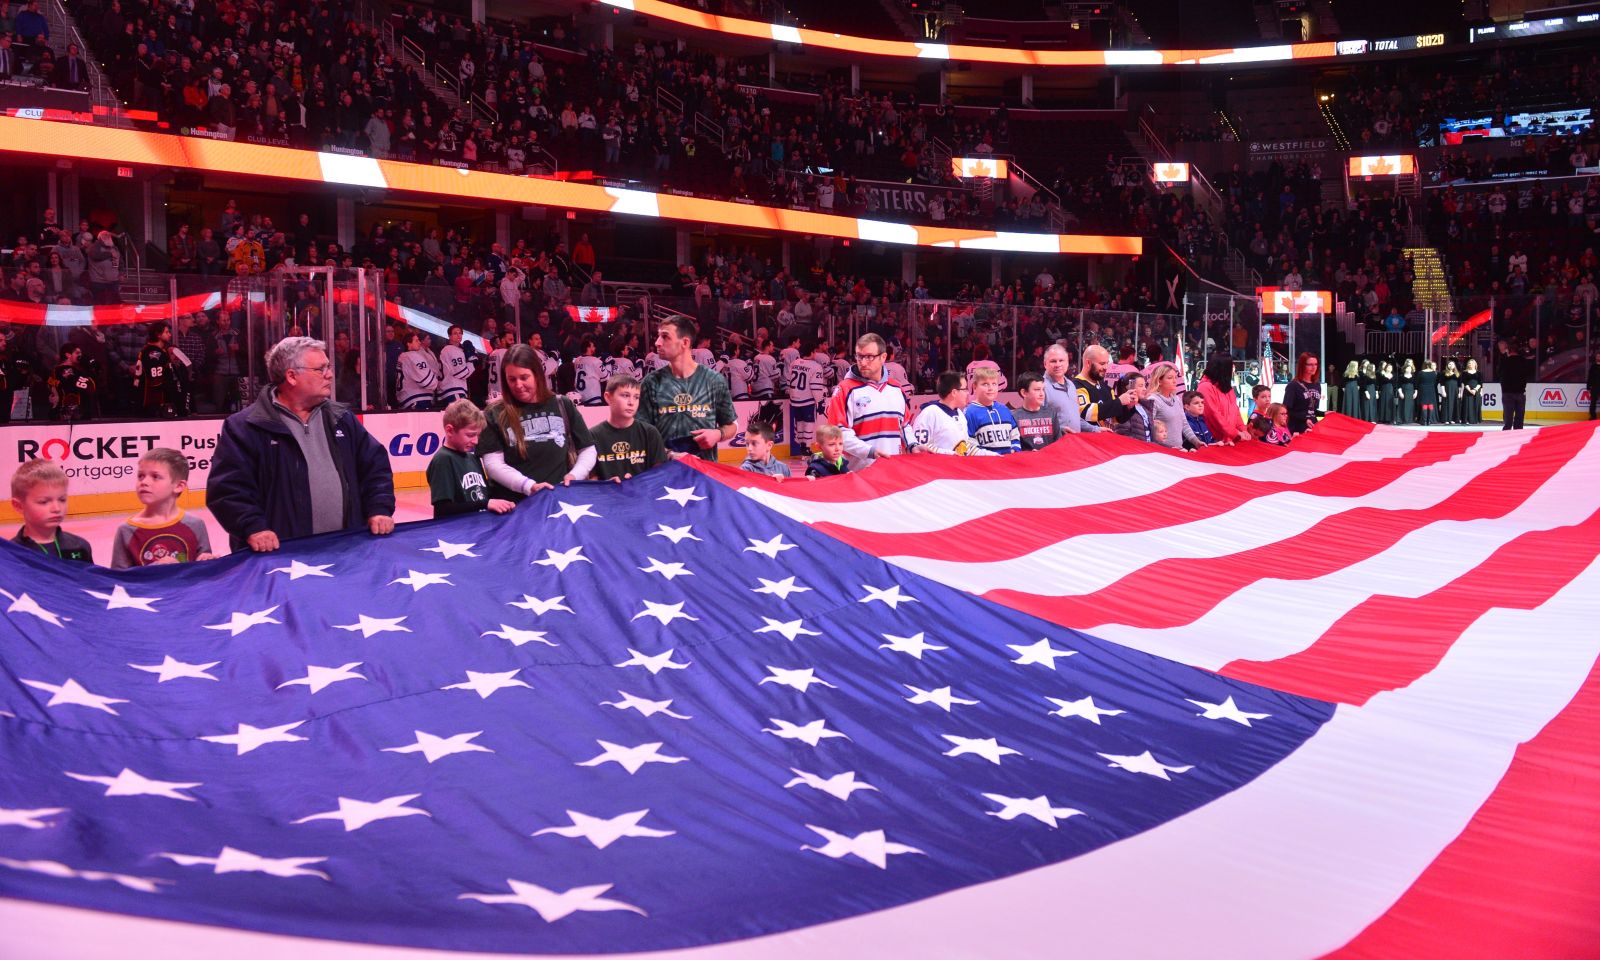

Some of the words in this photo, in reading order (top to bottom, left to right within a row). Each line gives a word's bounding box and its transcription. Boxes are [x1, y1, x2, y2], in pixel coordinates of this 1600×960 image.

[1375, 40, 1398, 51] TOTAL
[1416, 34, 1444, 48] $1020
[190, 127, 228, 140] Huntington
[247, 135, 267, 144] CLUB
[268, 137, 290, 146] LEVEL
[330, 144, 364, 156] Huntington
[1262, 141, 1326, 151] WESTFIELD
[439, 158, 469, 169] Huntington
[416, 361, 427, 370] 30
[451, 357, 463, 367] 39
[151, 366, 163, 378] 82
[790, 371, 806, 391] 20
[658, 404, 711, 415] MEDINA
[1032, 417, 1053, 427] STATE
[1023, 426, 1051, 435] BUCKEYES
[18, 435, 160, 463] ROCKET
[598, 450, 647, 462] MEDINA
[60, 462, 134, 480] ortgage
